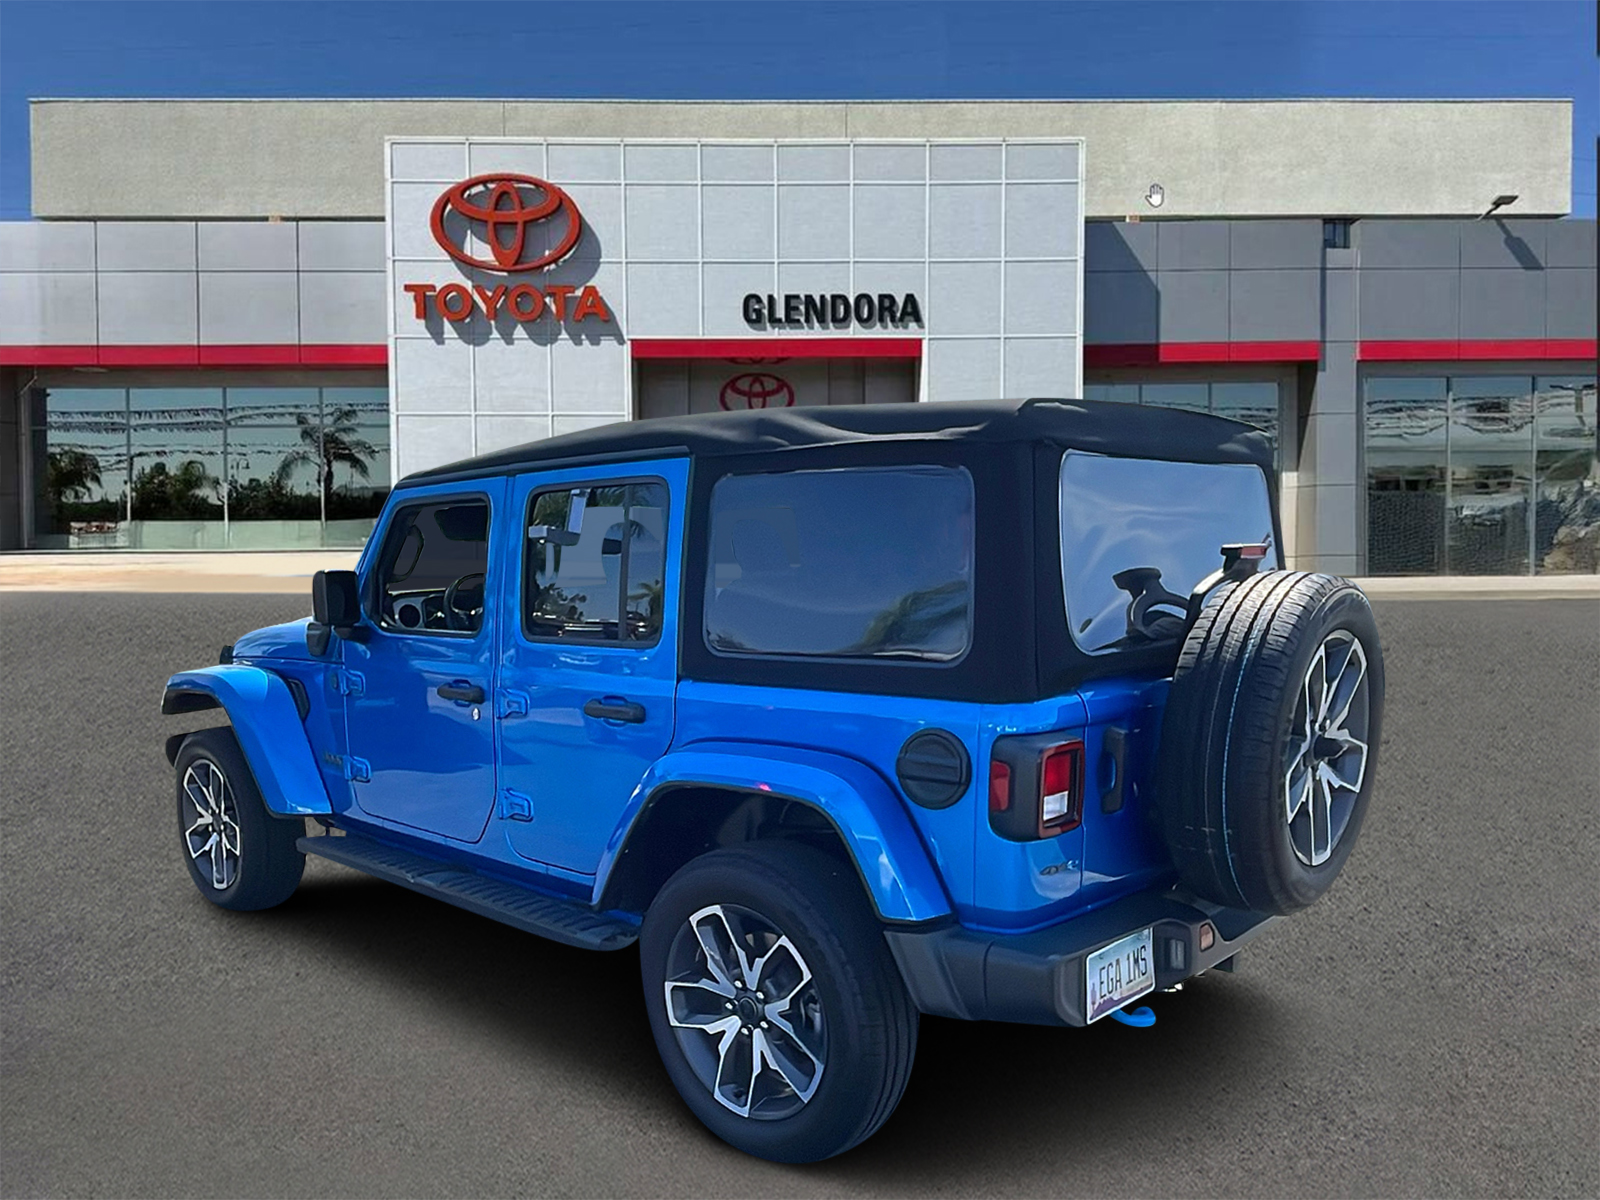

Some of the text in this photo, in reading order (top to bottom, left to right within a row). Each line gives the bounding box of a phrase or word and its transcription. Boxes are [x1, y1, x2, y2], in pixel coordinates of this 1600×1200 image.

[404, 283, 610, 322] TOYOTA
[743, 293, 923, 325] GLENDORA
[1098, 957, 1122, 999] EGA
